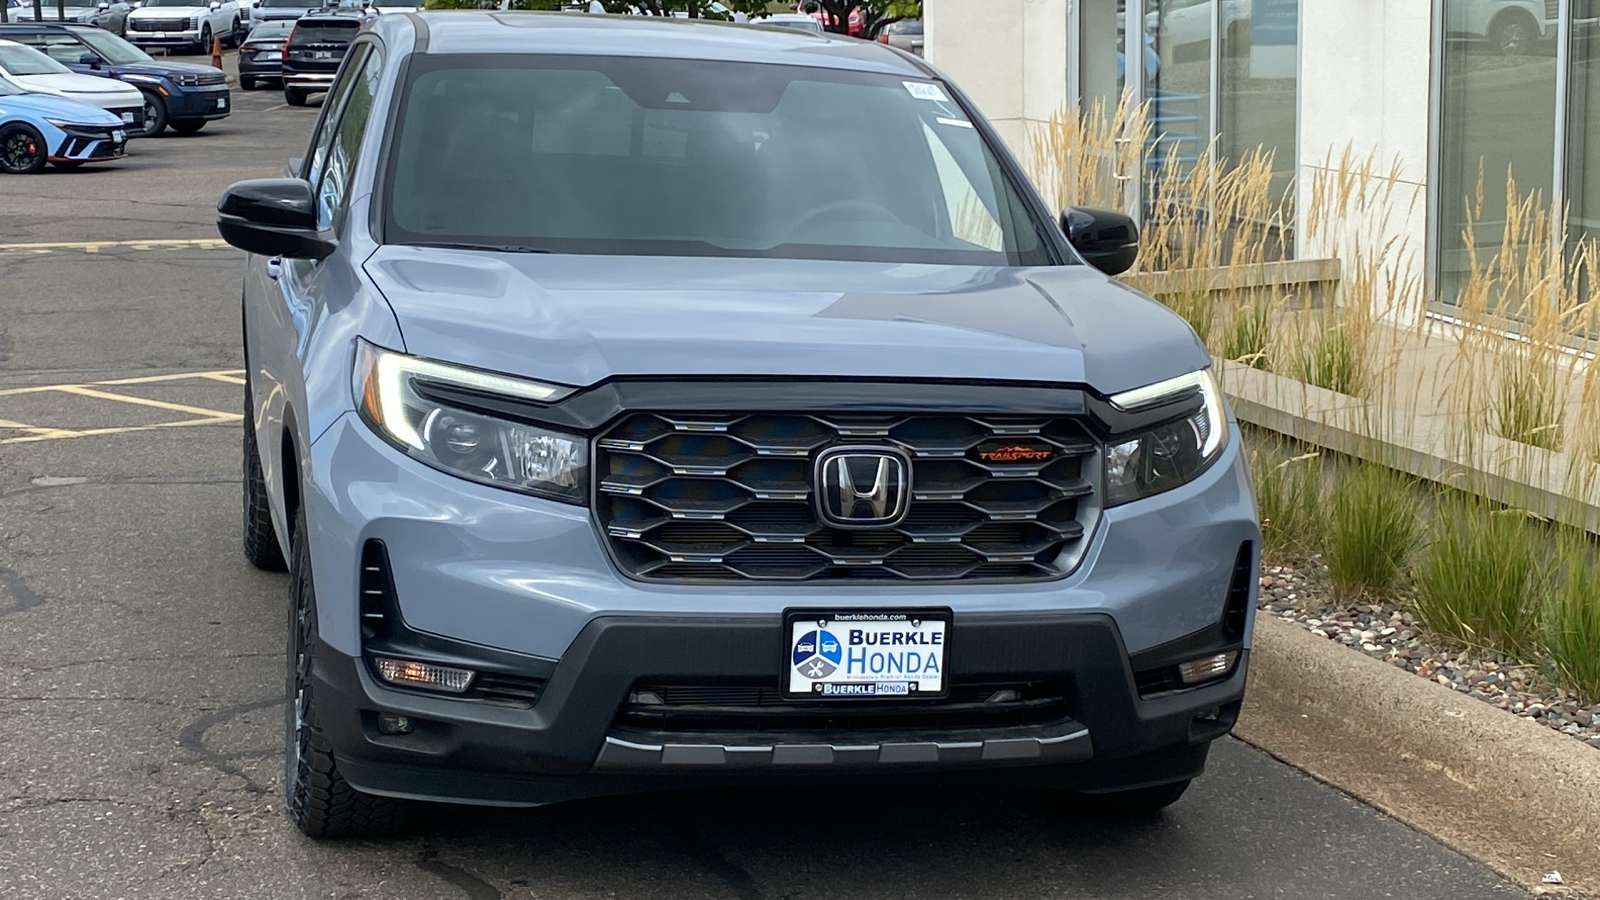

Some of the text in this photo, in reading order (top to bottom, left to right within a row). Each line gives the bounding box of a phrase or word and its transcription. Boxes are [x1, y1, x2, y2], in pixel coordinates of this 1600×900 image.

[979, 451, 1051, 461] TRAILSPORT
[834, 613, 907, 621] buerklehonda.com
[848, 629, 943, 646] BUERKLE
[846, 646, 940, 674] HONDA
[823, 683, 906, 694] BUERKLE HONDA
